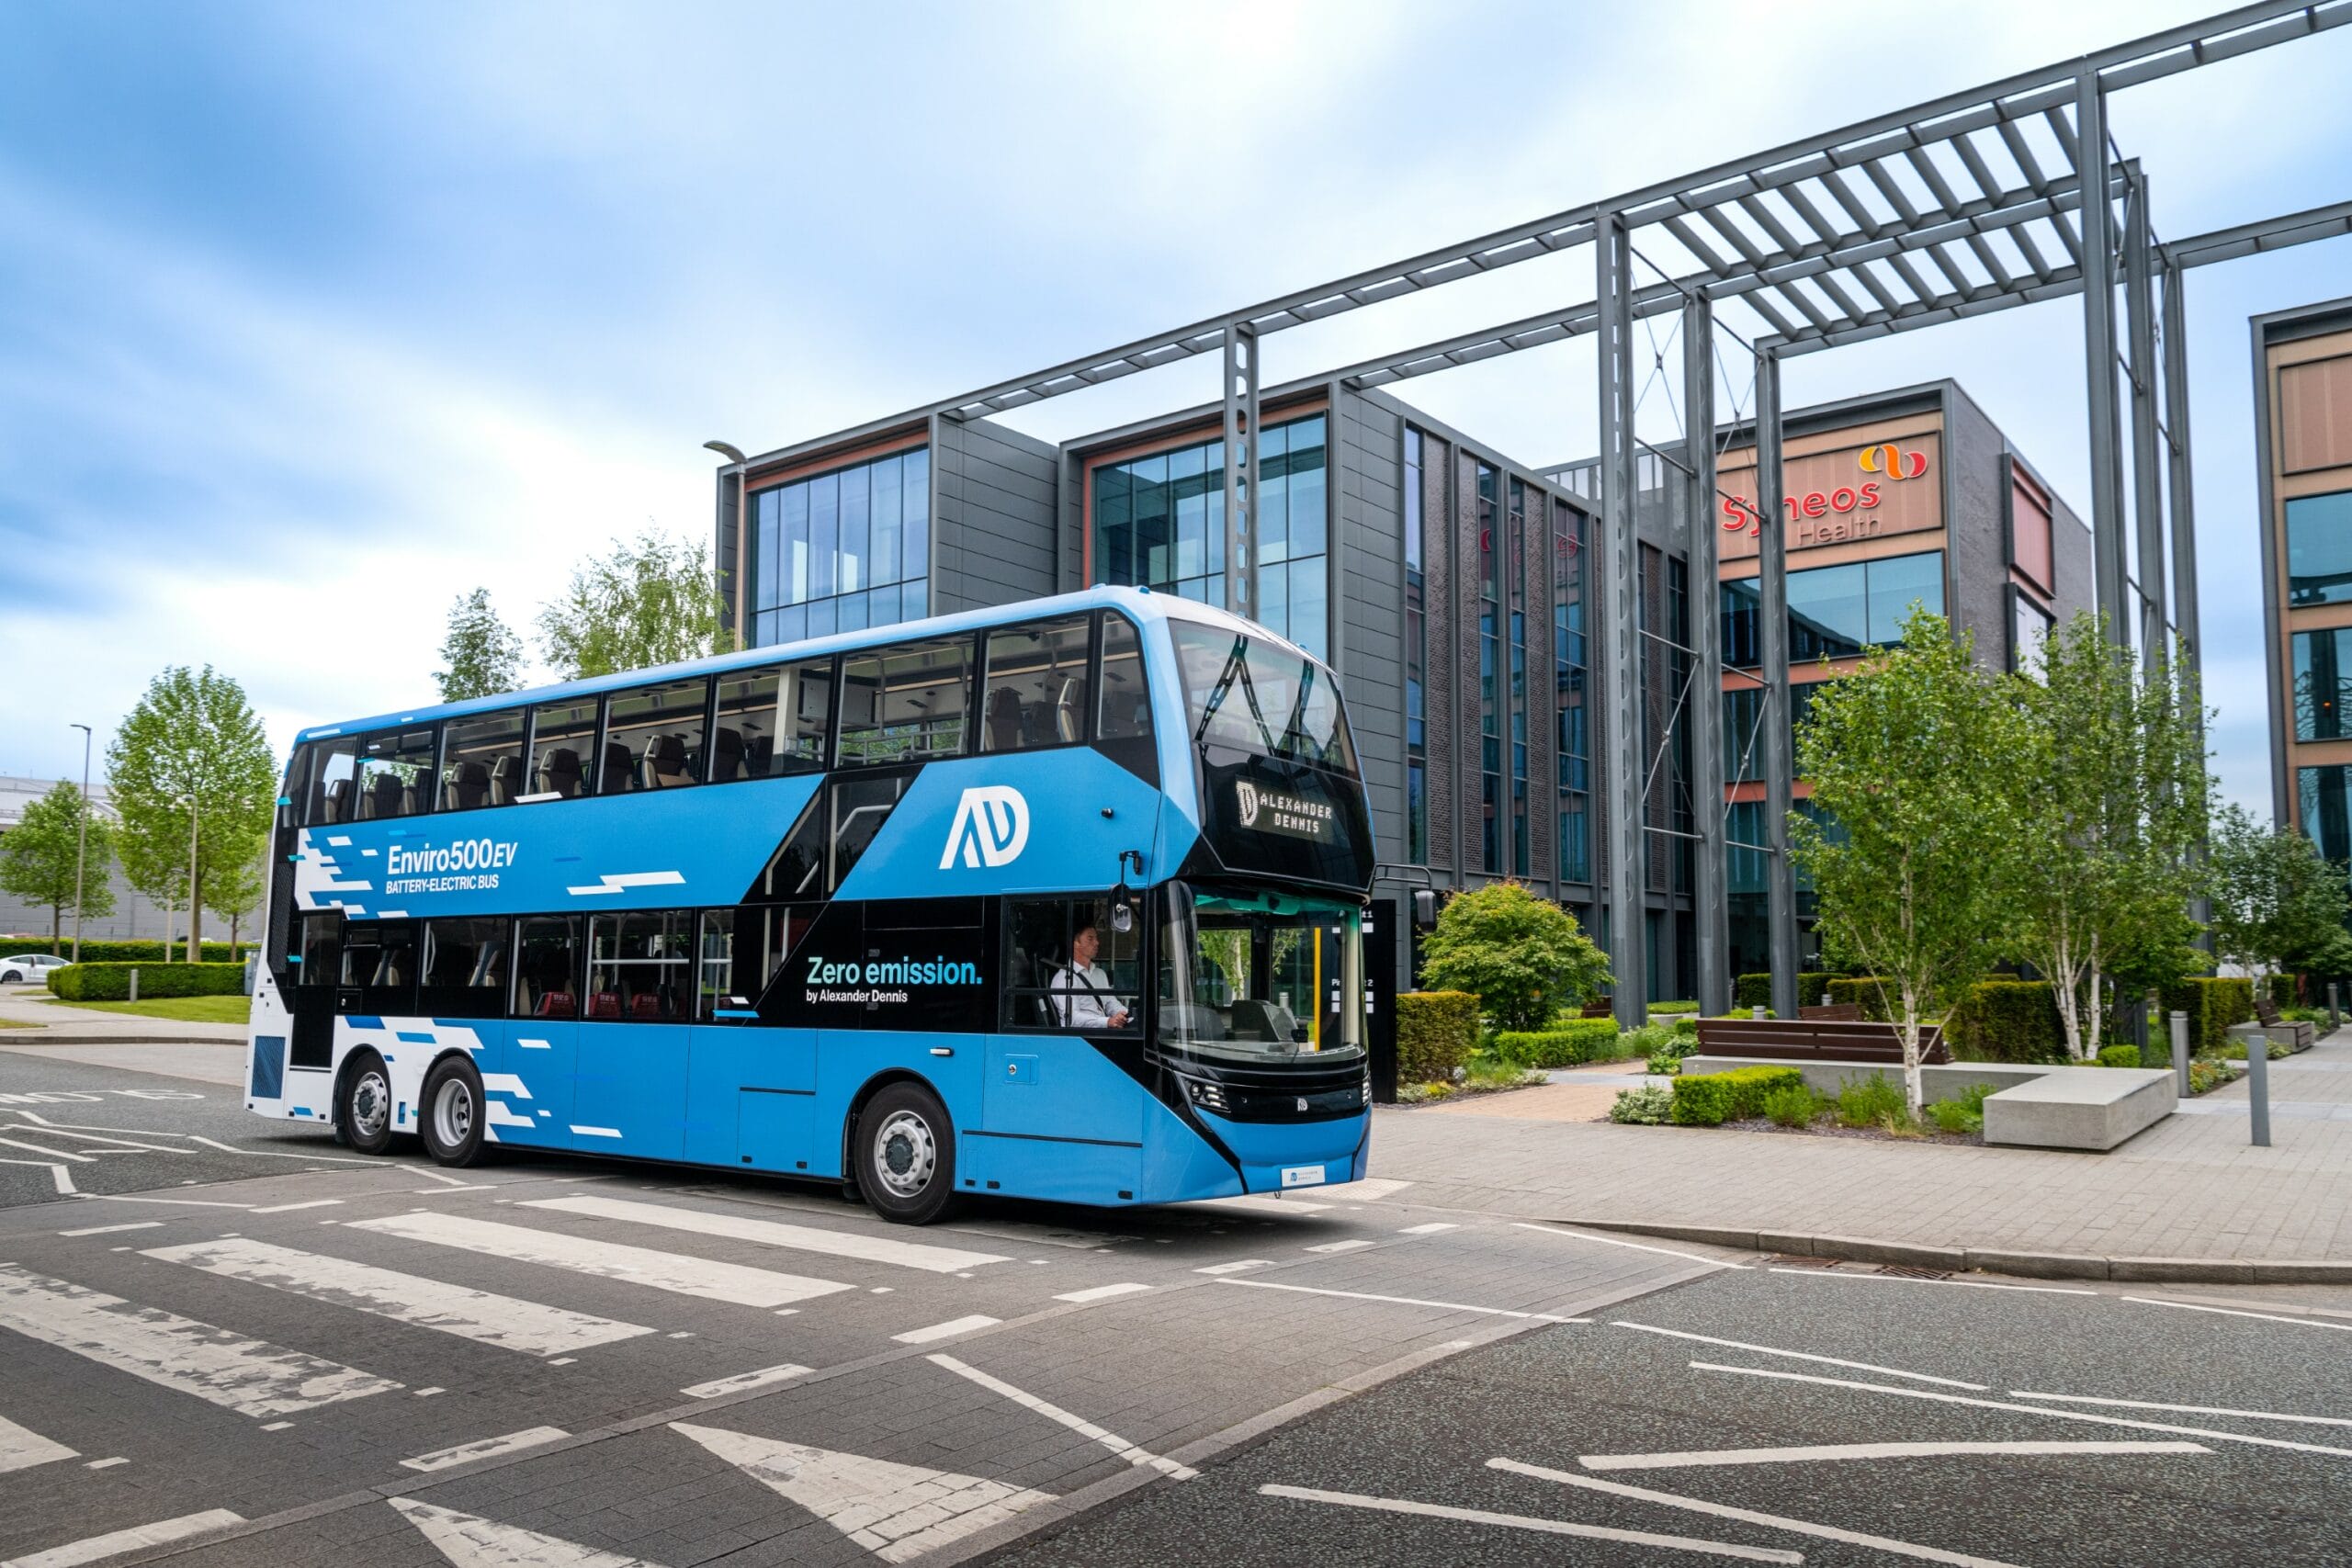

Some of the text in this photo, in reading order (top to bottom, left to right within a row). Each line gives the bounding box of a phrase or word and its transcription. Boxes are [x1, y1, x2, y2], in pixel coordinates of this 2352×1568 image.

[1797, 514, 1882, 545] Health
[1260, 793, 1331, 819] ALEXANDER
[1274, 812, 1319, 833] DENNIS
[386, 874, 499, 894] BATTERY-ELECTRIC BUS
[807, 955, 982, 985] Zero emission.
[806, 989, 909, 1004] by Alexander Dennis
